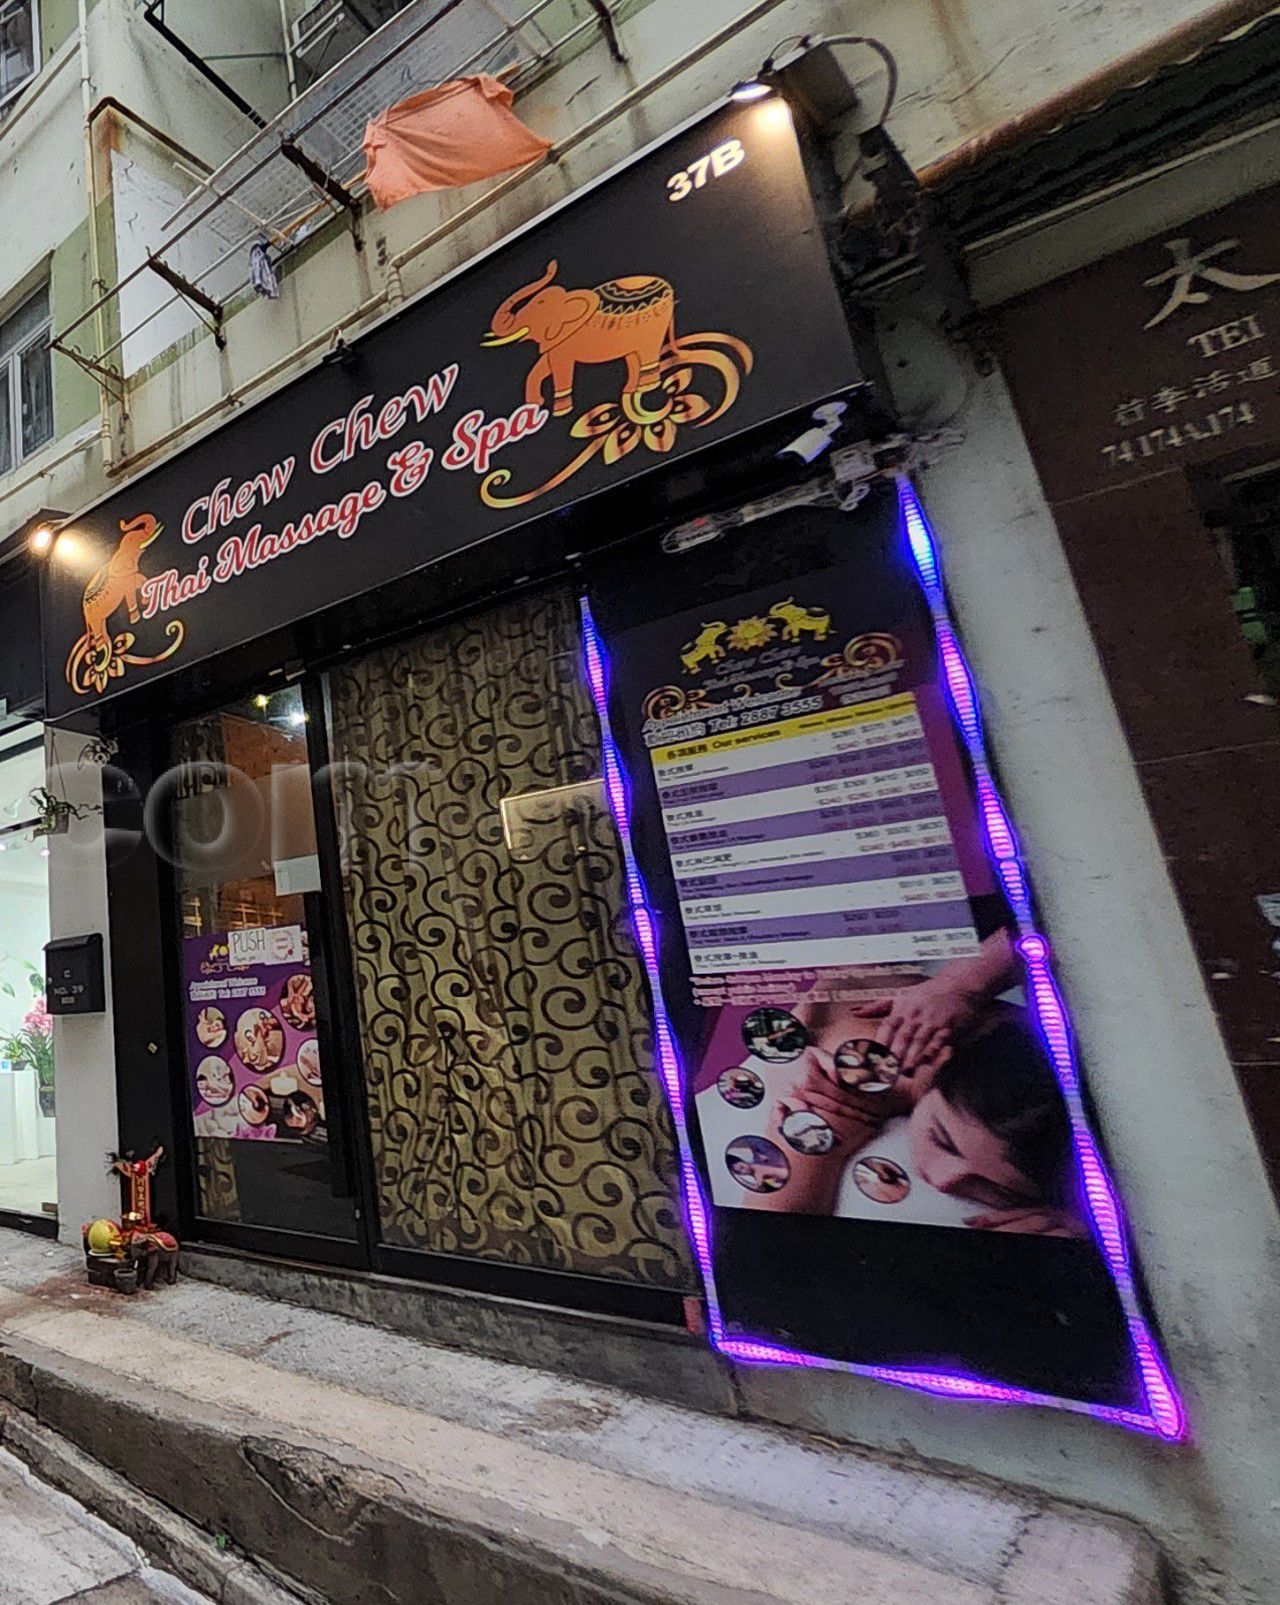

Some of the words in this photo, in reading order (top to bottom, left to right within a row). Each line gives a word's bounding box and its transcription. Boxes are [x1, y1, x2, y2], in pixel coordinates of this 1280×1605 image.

[666, 139, 746, 202] 37B
[181, 455, 296, 545] Chew
[310, 363, 459, 474] Chew
[141, 556, 210, 620] Thai
[214, 481, 387, 583] Massage
[387, 441, 435, 497] &
[441, 403, 550, 474] Spa
[740, 704, 780, 726] 2887
[781, 695, 824, 718] 3555
[712, 738, 732, 749] Our
[735, 728, 781, 746] services
[232, 930, 266, 953] PUSH
